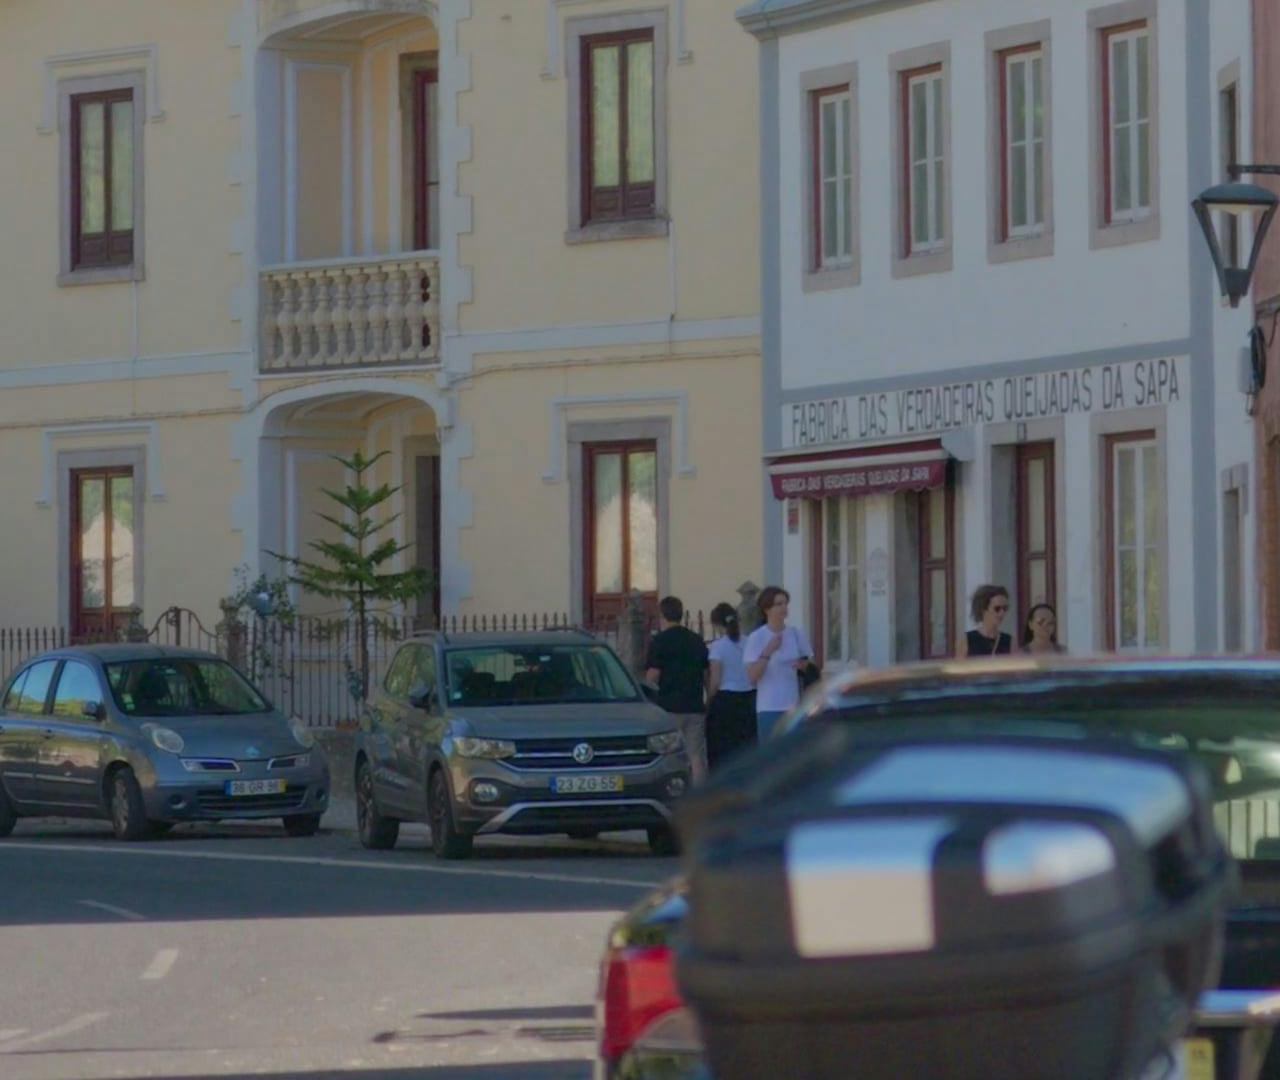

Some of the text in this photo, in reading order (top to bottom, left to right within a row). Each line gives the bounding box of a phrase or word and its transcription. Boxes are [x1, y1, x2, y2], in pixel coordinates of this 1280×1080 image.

[792, 359, 1180, 447] FABRICA DAS VERDADEIRAS QUEIJADAS DA SAPA
